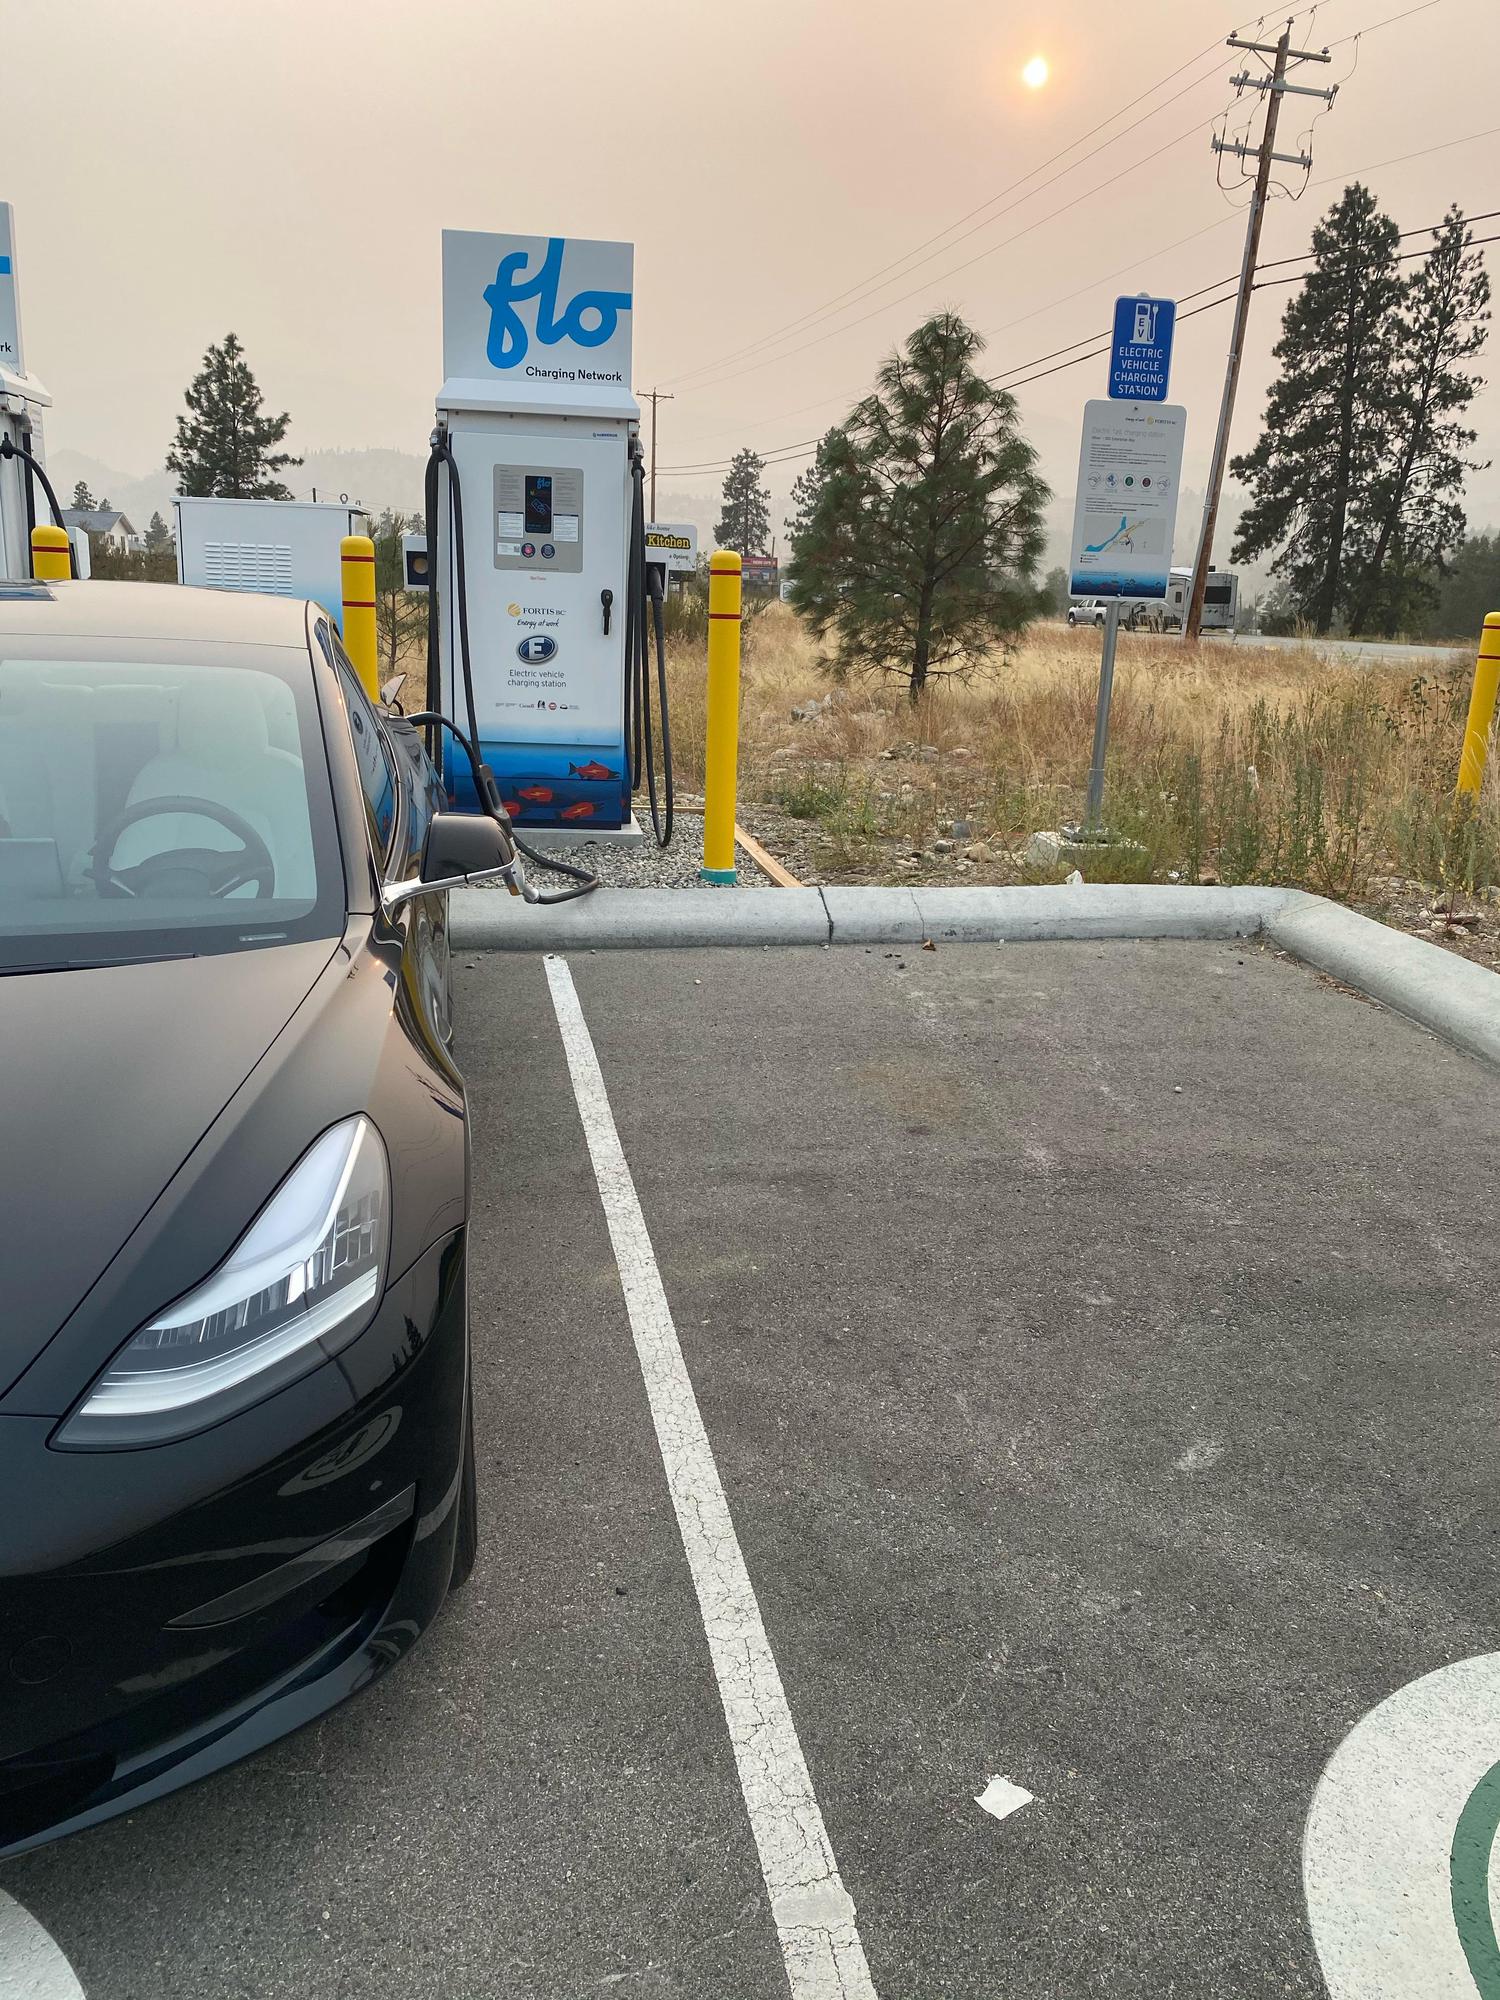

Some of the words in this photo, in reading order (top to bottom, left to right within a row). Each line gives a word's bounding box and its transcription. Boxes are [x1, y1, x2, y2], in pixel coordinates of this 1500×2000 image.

[483, 237, 632, 369] flo
[1119, 346, 1164, 359] ELECTRIC
[1121, 359, 1160, 371] VEHICLE
[525, 366, 575, 381] Charging
[578, 369, 622, 382] Network
[1114, 371, 1164, 384] CHARGING
[1117, 384, 1158, 396] STATION
[647, 534, 691, 549] Kitchen
[523, 607, 555, 616] FORTIS
[517, 619, 538, 629] Energy
[546, 618, 560, 627] work
[509, 669, 537, 678] Electric
[539, 670, 565, 679] vehicle
[507, 679, 540, 688] charging
[541, 679, 567, 688] station
